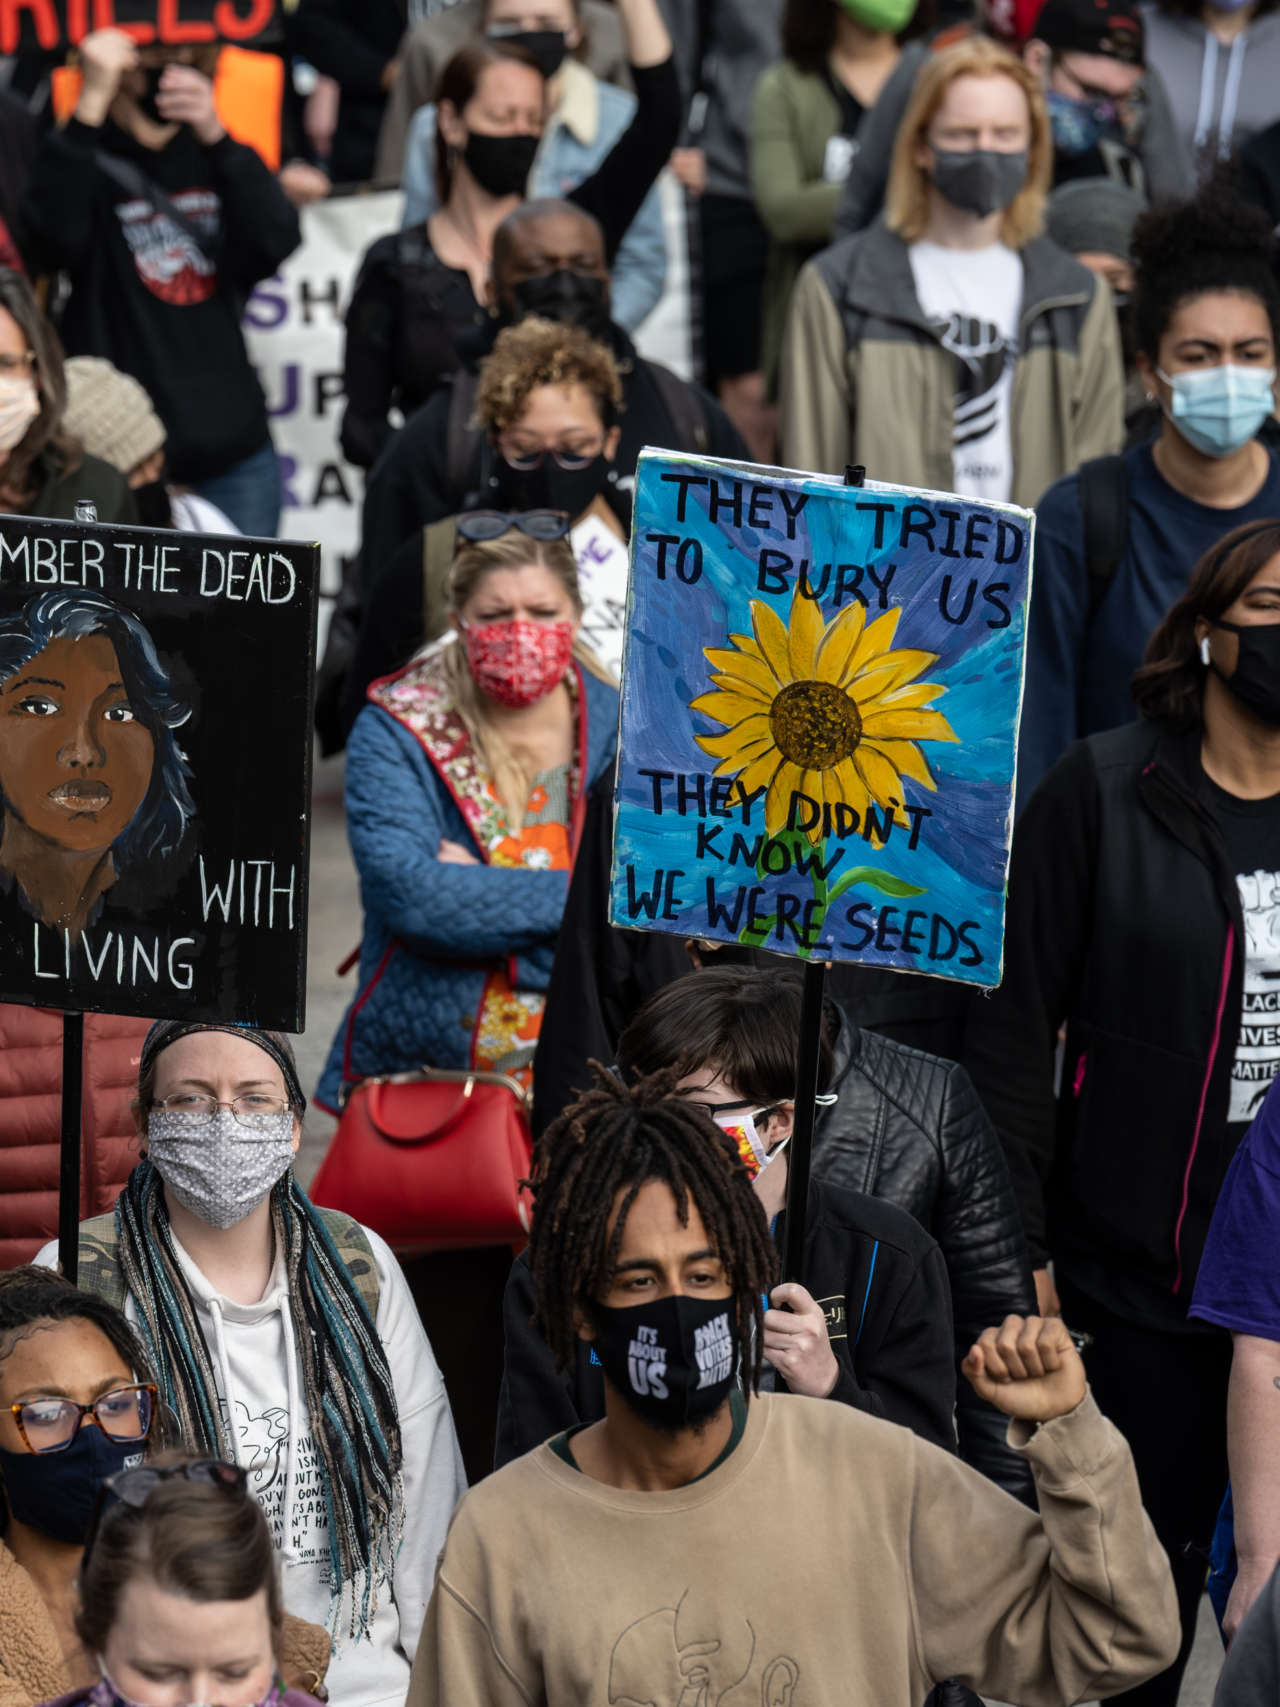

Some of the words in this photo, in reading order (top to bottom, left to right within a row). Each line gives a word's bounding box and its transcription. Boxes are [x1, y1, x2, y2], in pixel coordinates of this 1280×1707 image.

[659, 472, 811, 541] THEY
[855, 502, 1022, 565] TRIED
[113, 543, 181, 593] THE
[199, 548, 297, 604] DEAD
[645, 533, 704, 585] TO
[756, 548, 898, 610] BURY
[938, 574, 1013, 630] US
[637, 768, 768, 826] THEY
[786, 789, 934, 851] DIDN'T
[695, 821, 847, 880] KNOW
[198, 853, 296, 929] WITH
[625, 863, 686, 921] WE
[705, 875, 832, 951] WERE
[840, 901, 985, 967] SEEDS
[34, 922, 196, 990] LIVING
[628, 1340, 667, 1363] ABOUT
[637, 1324, 658, 1346] IT'S
[627, 1356, 670, 1400] US
